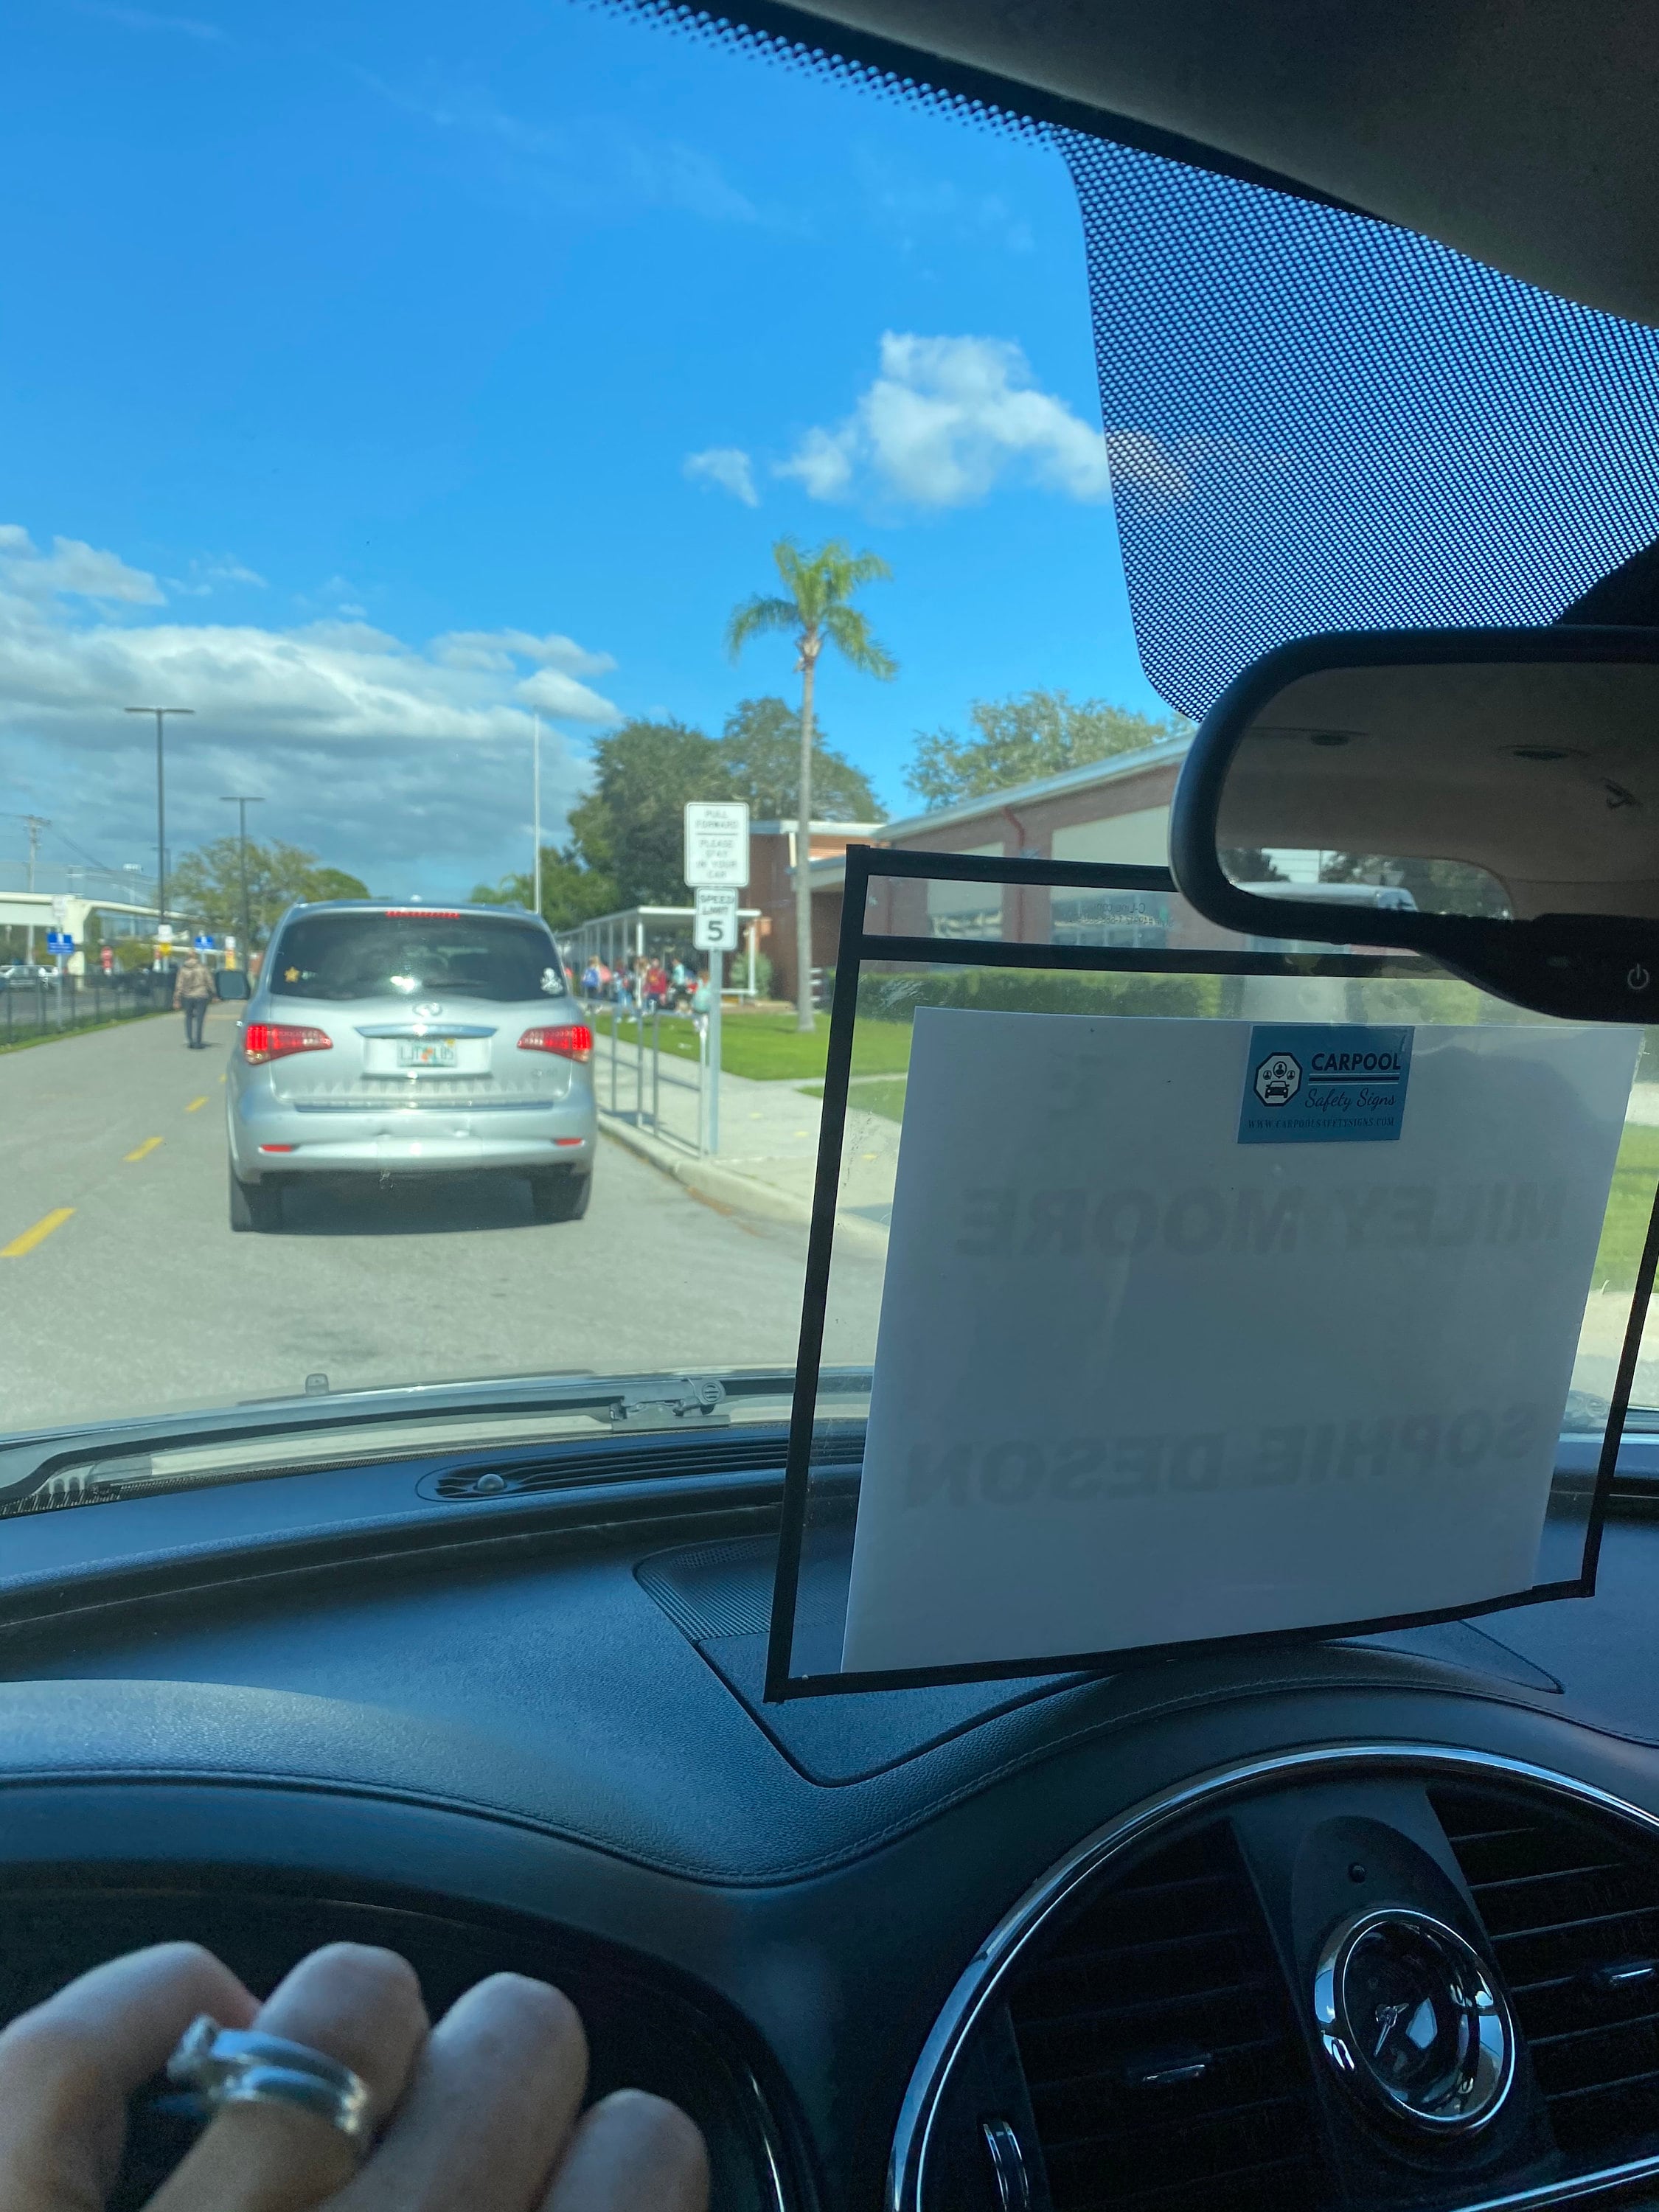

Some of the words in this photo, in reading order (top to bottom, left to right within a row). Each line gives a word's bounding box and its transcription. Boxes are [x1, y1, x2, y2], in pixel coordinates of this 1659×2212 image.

[700, 894, 734, 903] SPEED
[702, 906, 728, 915] LIMIT
[708, 920, 724, 942] 5
[1312, 1052, 1401, 1071] CARPOOL
[1304, 1088, 1353, 1112] Safety
[1357, 1087, 1396, 1111] Signs
[1248, 1116, 1394, 1129] WWW.CARPOOLSAFETYSIGNS.COM
